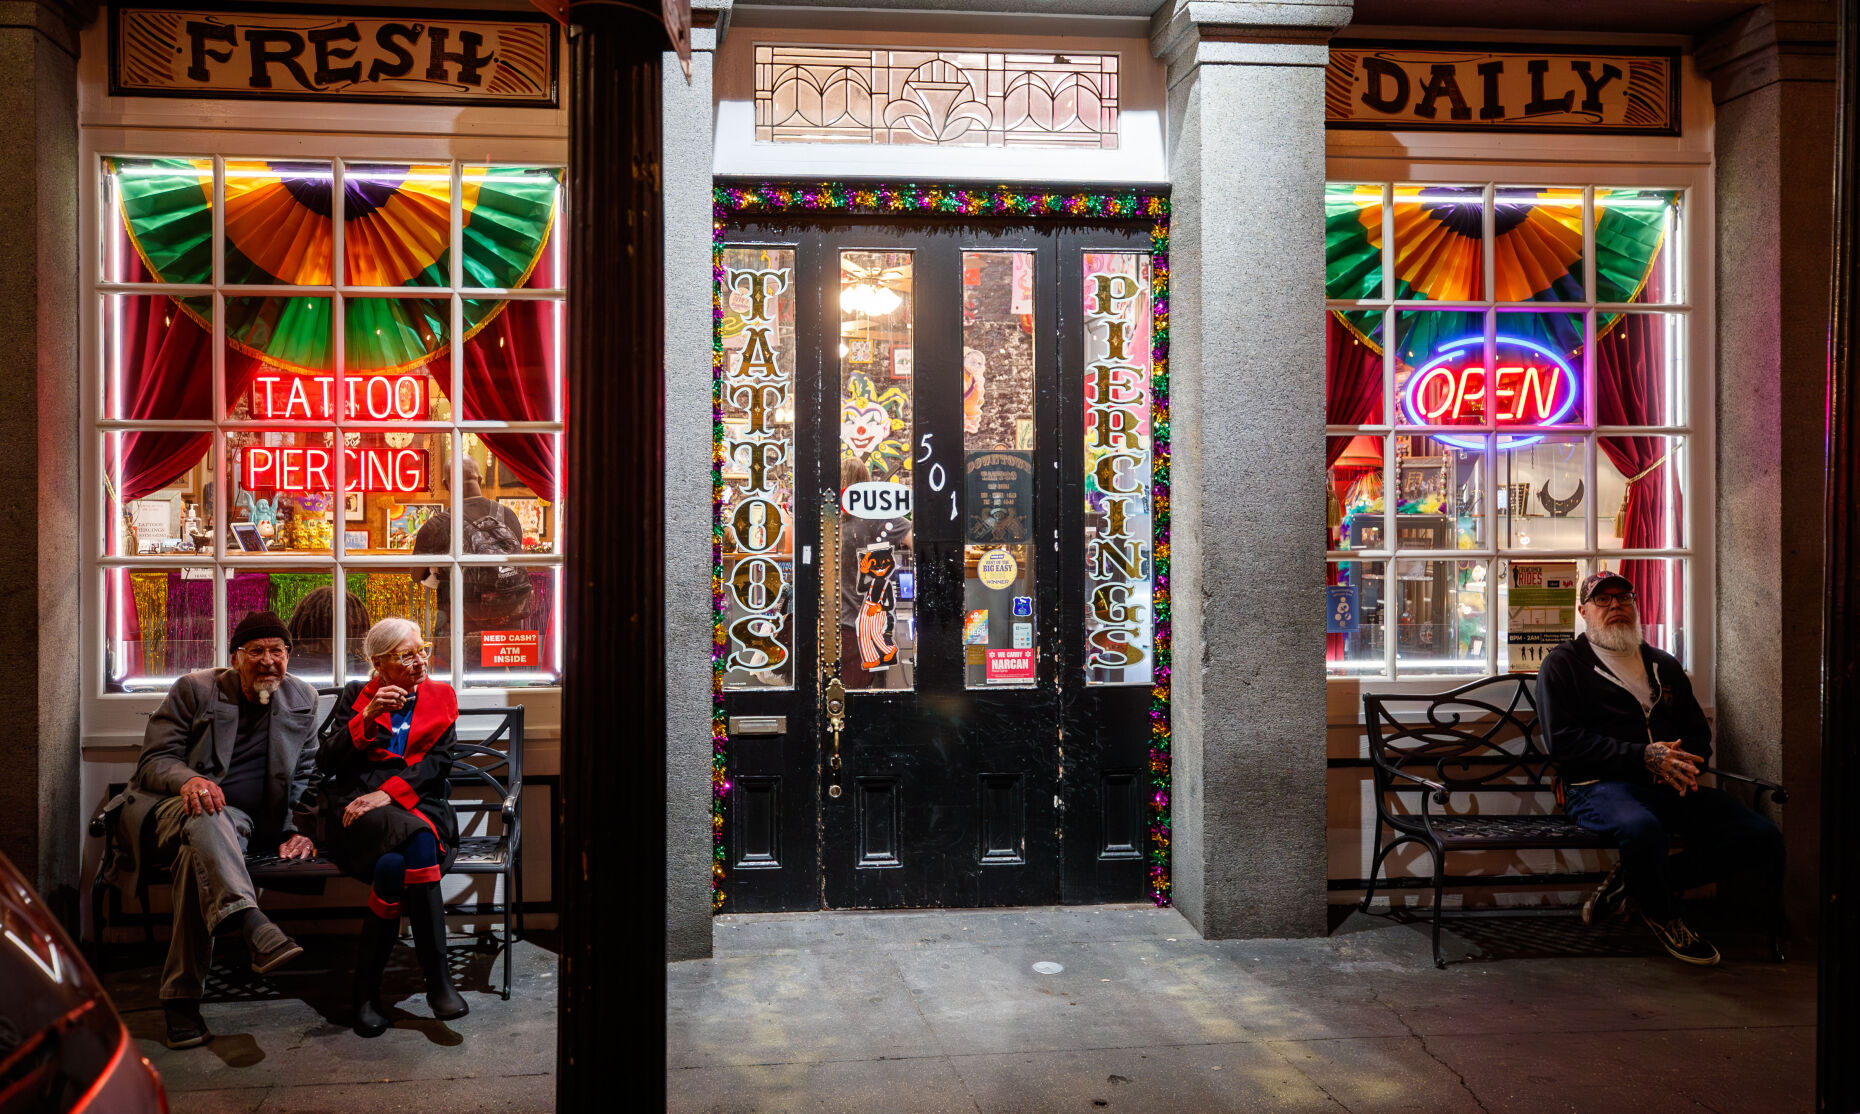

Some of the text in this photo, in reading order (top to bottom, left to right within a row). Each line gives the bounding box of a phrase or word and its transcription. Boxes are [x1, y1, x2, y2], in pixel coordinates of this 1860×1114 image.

[186, 21, 495, 92] FRESH
[1360, 56, 1623, 120] DAILY
[257, 376, 420, 418] TATTOO
[1417, 367, 1560, 419] OPEN
[724, 268, 791, 672] TATTOOS
[917, 433, 958, 520] 501
[1086, 273, 1148, 670] PIERCINGS
[849, 490, 910, 511] PUSH
[1518, 572, 1542, 584] RIDES
[493, 655, 527, 663] INSIDE
[991, 659, 1029, 669] NARCAN
